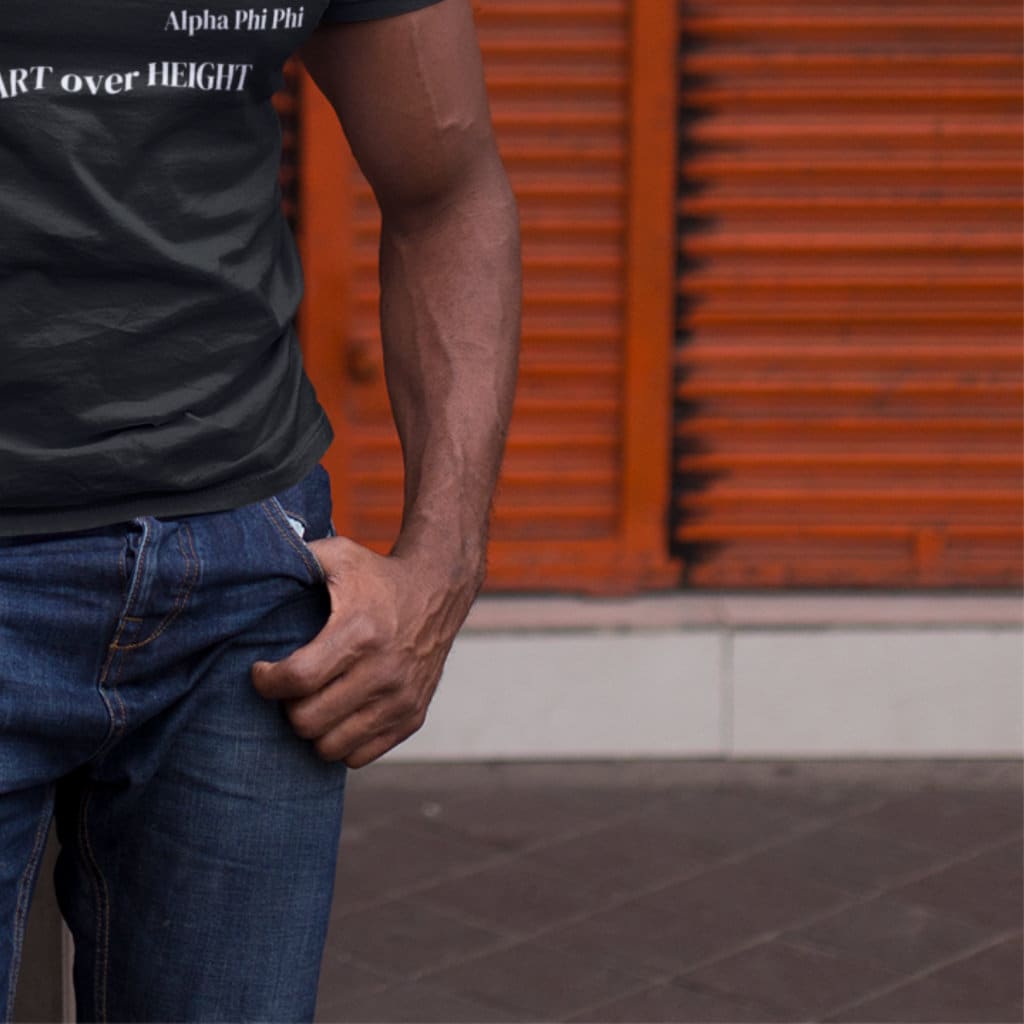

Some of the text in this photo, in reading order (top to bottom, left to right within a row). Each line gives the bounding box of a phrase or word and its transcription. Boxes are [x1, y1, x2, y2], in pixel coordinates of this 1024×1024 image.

[164, 6, 305, 37] Alpha Phi Phi
[60, 70, 141, 94] over
[147, 62, 254, 92] HEIGHT
